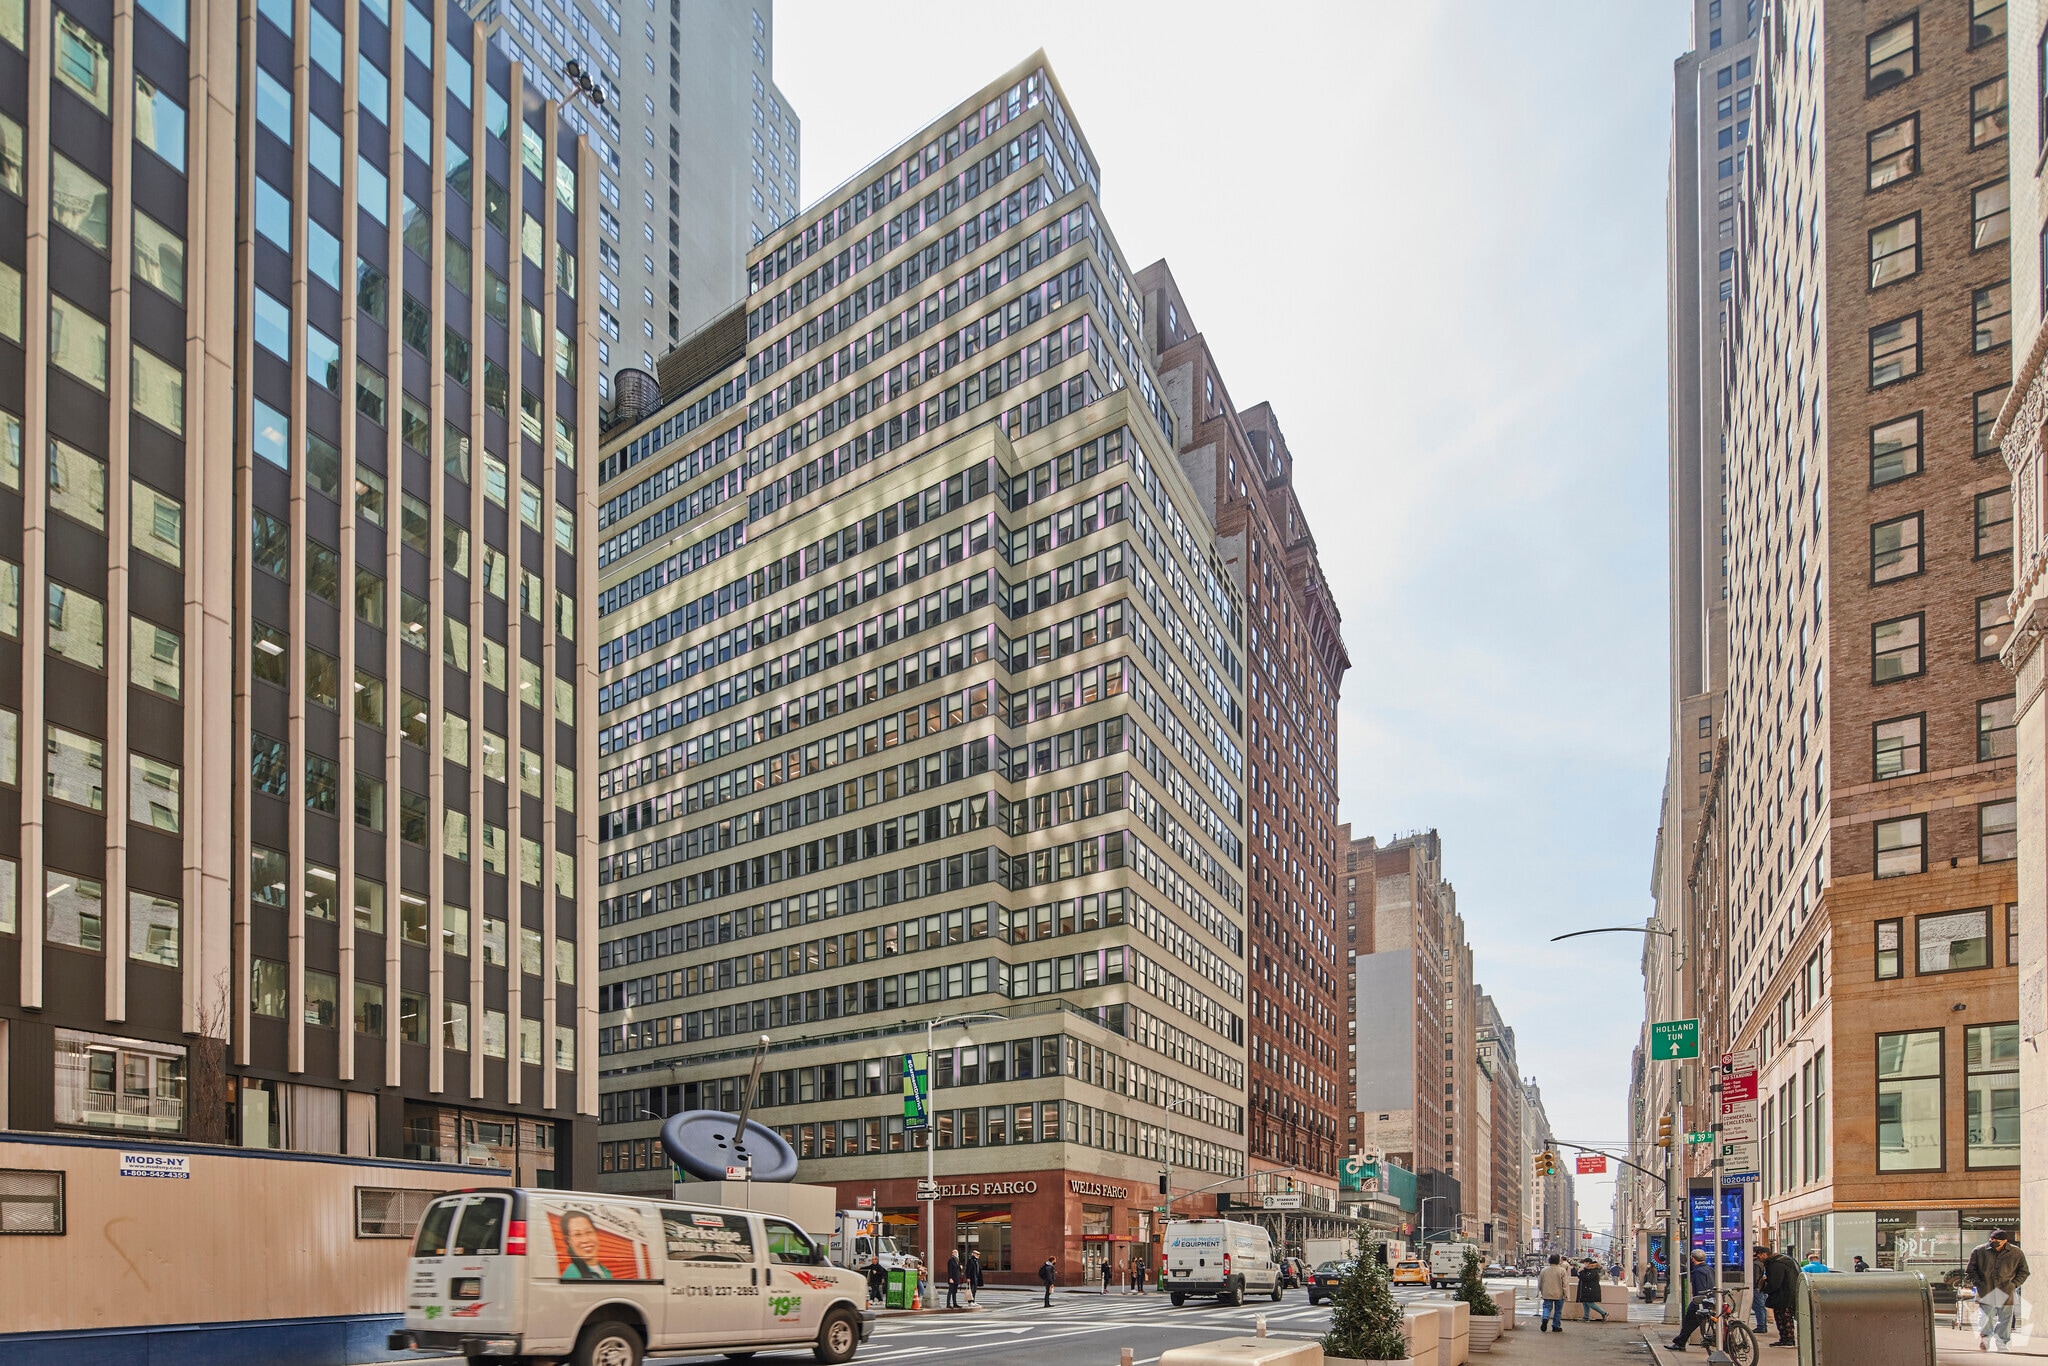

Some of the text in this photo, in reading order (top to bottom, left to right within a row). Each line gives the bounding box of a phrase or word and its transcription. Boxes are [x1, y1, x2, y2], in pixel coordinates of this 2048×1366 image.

[1656, 1023, 1694, 1033] HOLLAND
[1730, 1071, 1753, 1080] STANDING
[1724, 1104, 1731, 1114] 3
[1723, 1113, 1752, 1122] COMMERCIAL
[1689, 1134, 1696, 1143] W
[1697, 1133, 1706, 1142] 39
[1902, 1134, 1940, 1148] SPA
[1969, 1127, 1997, 1144] 530
[1724, 1145, 1732, 1155] 5
[125, 1155, 185, 1166] MODS-NY
[938, 1180, 1037, 1197] ELLS FARGO
[1071, 1180, 1128, 1199] WELLS FARGO
[676, 1226, 742, 1243] Parkslope
[671, 1287, 685, 1296] Call
[686, 1285, 713, 1297] (718)
